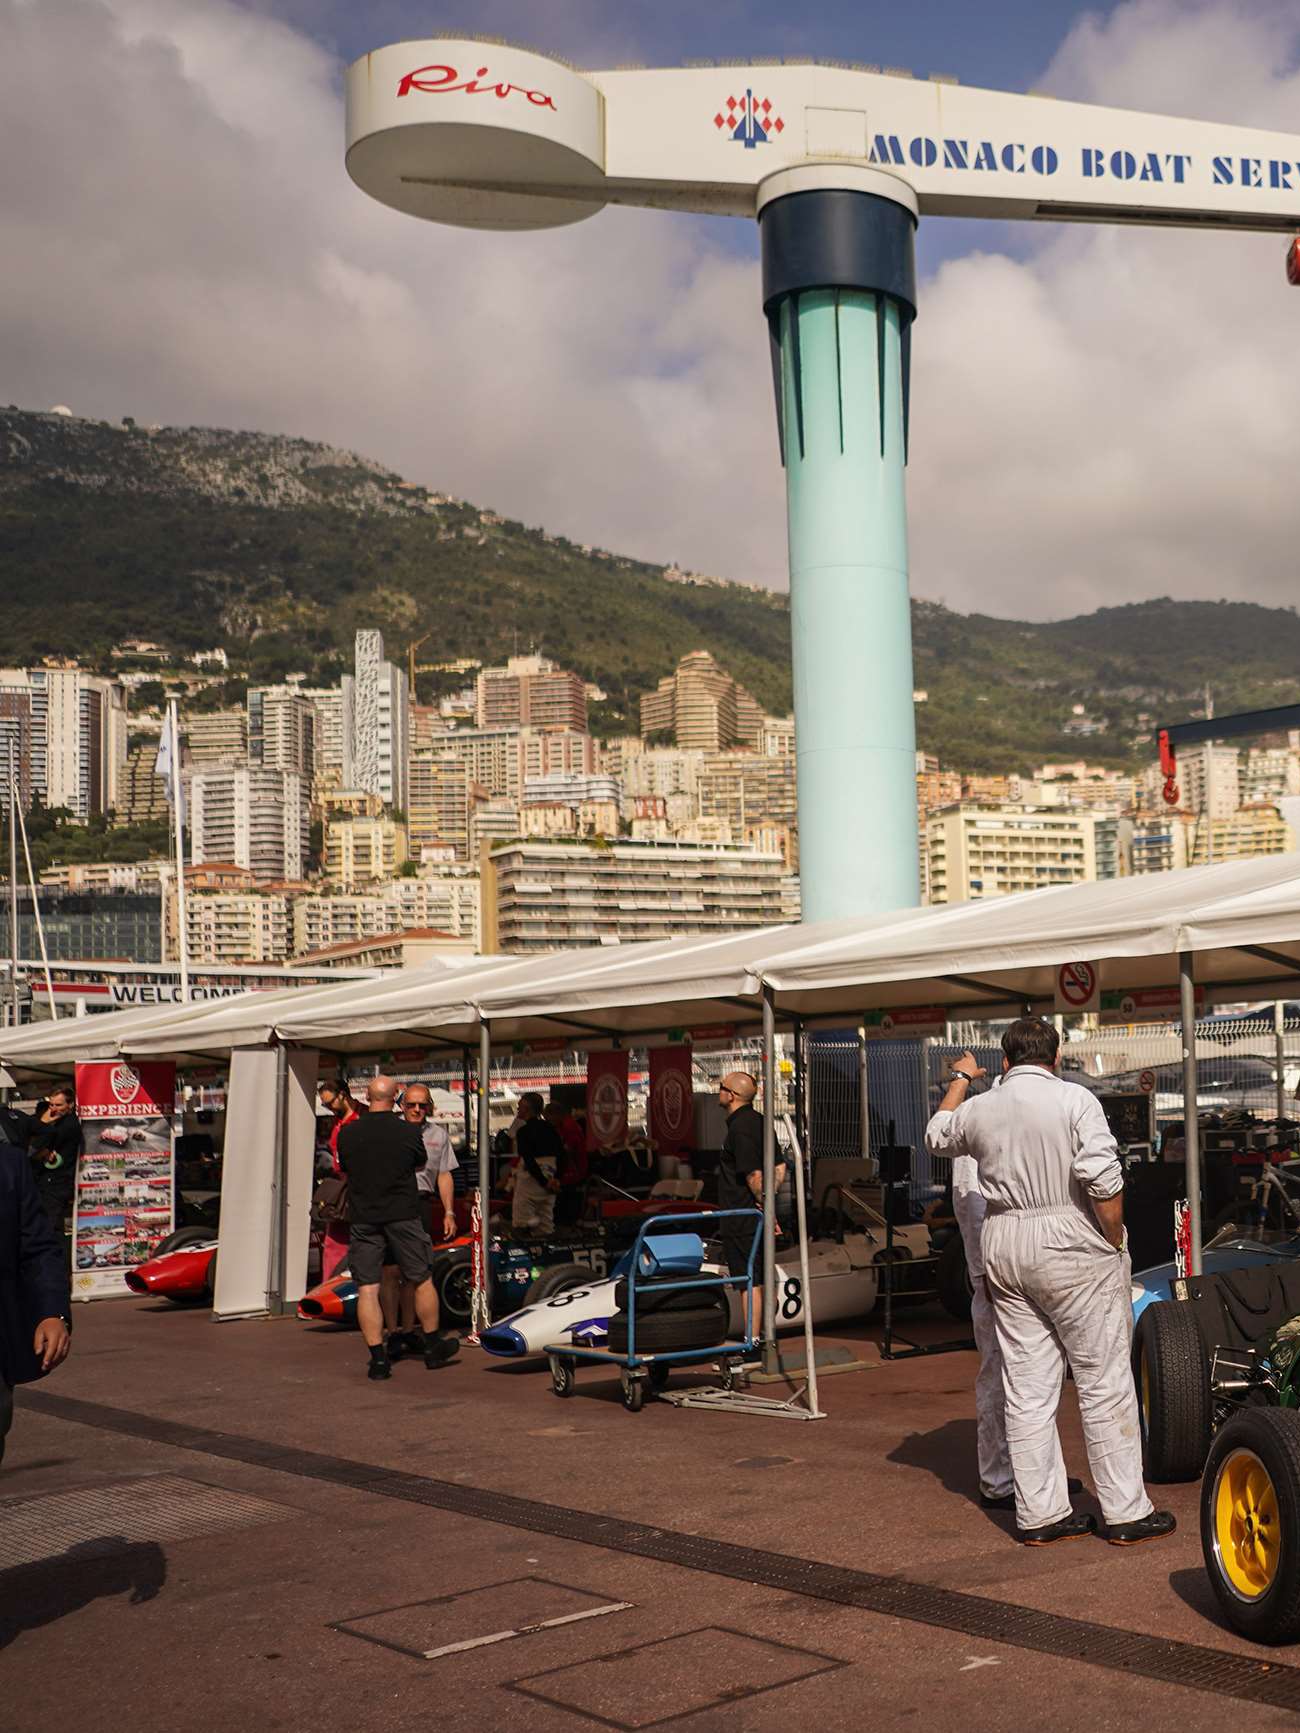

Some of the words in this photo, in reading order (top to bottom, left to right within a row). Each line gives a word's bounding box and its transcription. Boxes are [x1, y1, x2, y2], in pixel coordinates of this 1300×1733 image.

[397, 64, 557, 111] Riva
[868, 133, 1058, 177] MONACO
[1081, 138, 1192, 185] BOAT
[113, 986, 245, 1003] WELCOM
[80, 1103, 172, 1116] EXPERIENCE
[573, 1248, 607, 1278] 56
